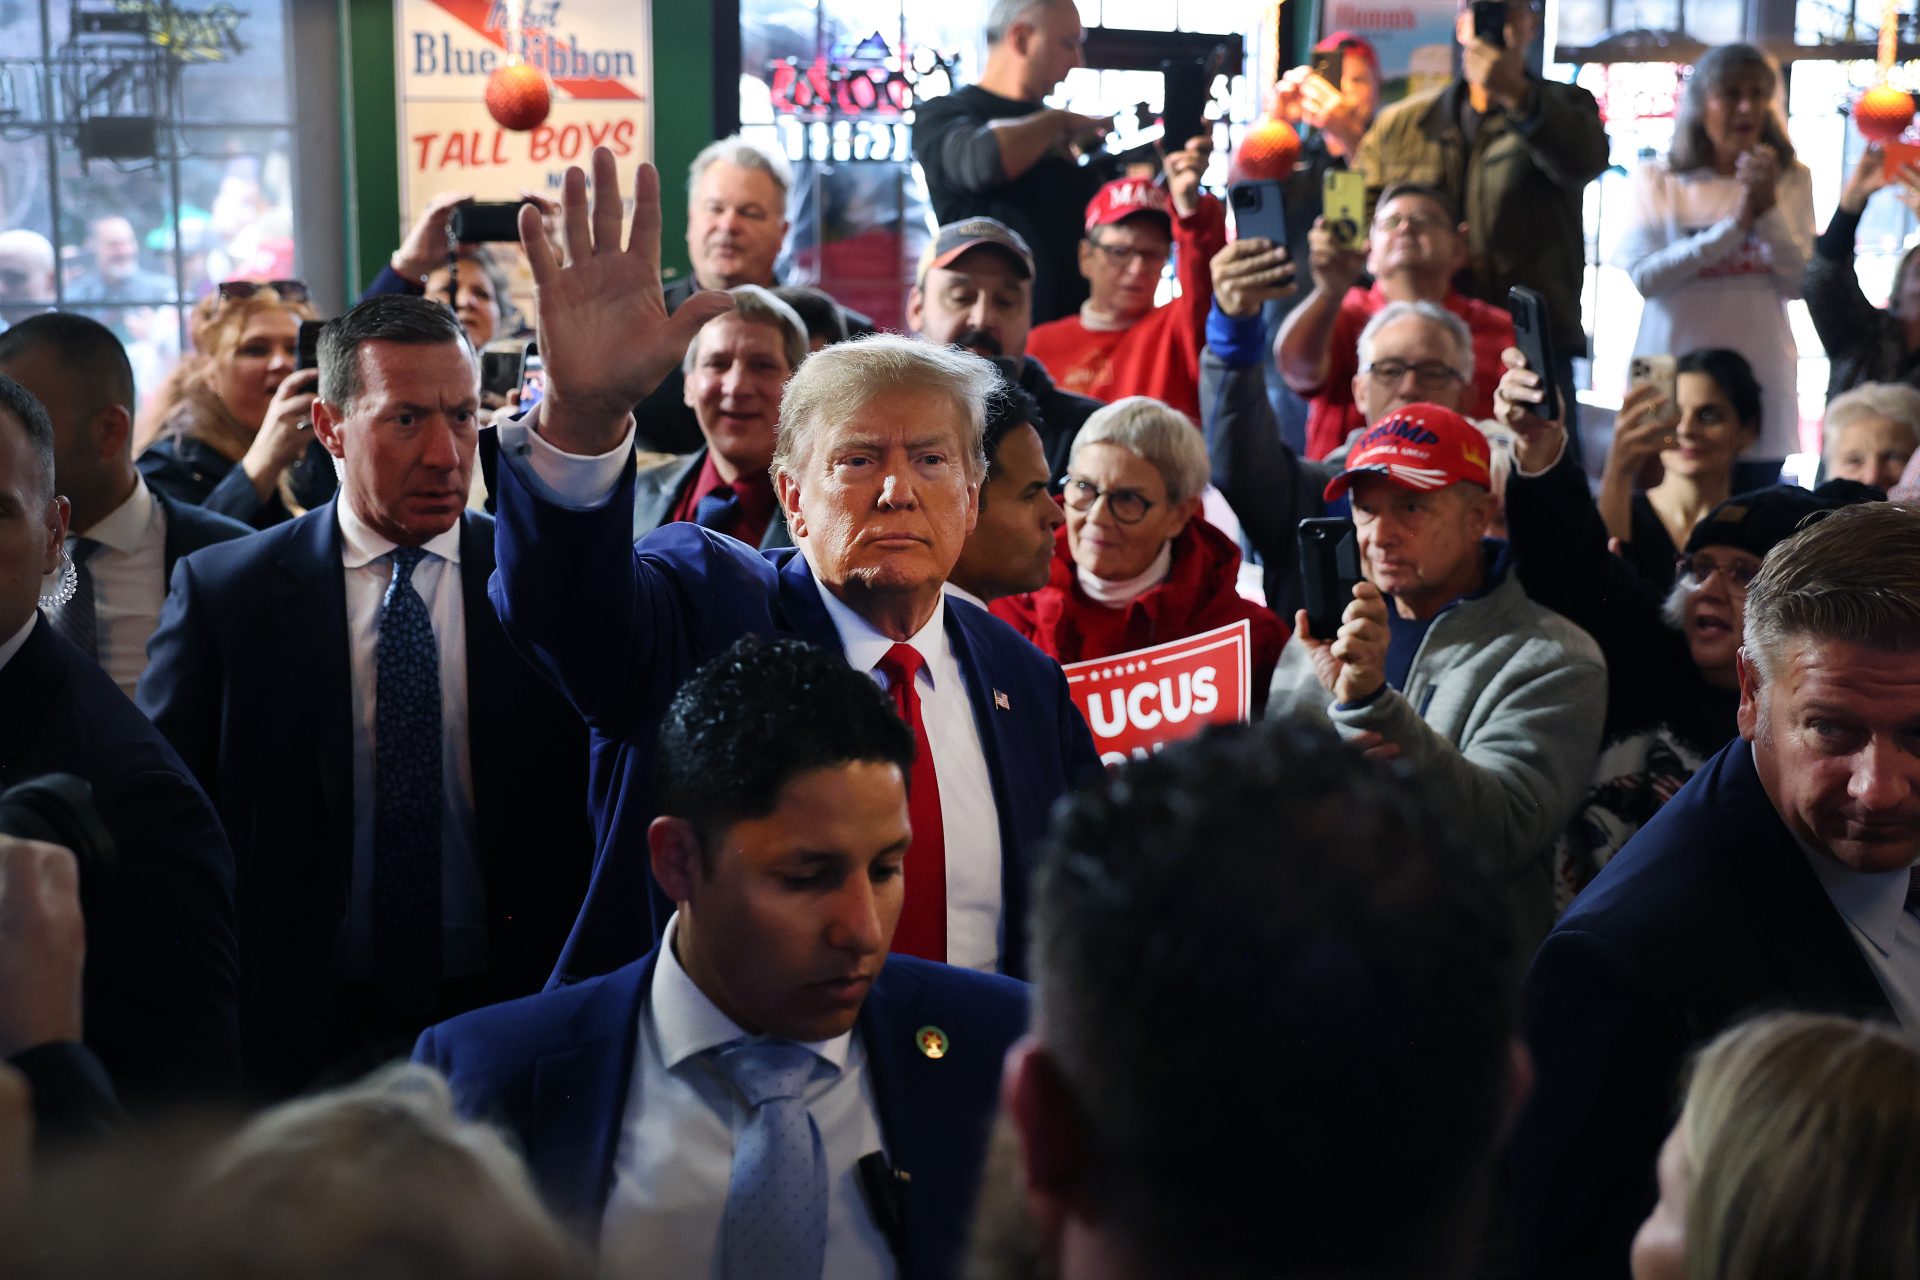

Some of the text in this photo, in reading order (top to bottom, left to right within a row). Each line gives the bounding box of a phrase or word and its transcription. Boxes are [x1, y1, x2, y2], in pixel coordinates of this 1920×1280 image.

[414, 32, 496, 76] Blue
[414, 119, 635, 171] TALL BOYS
[1360, 418, 1439, 449] TRUMP
